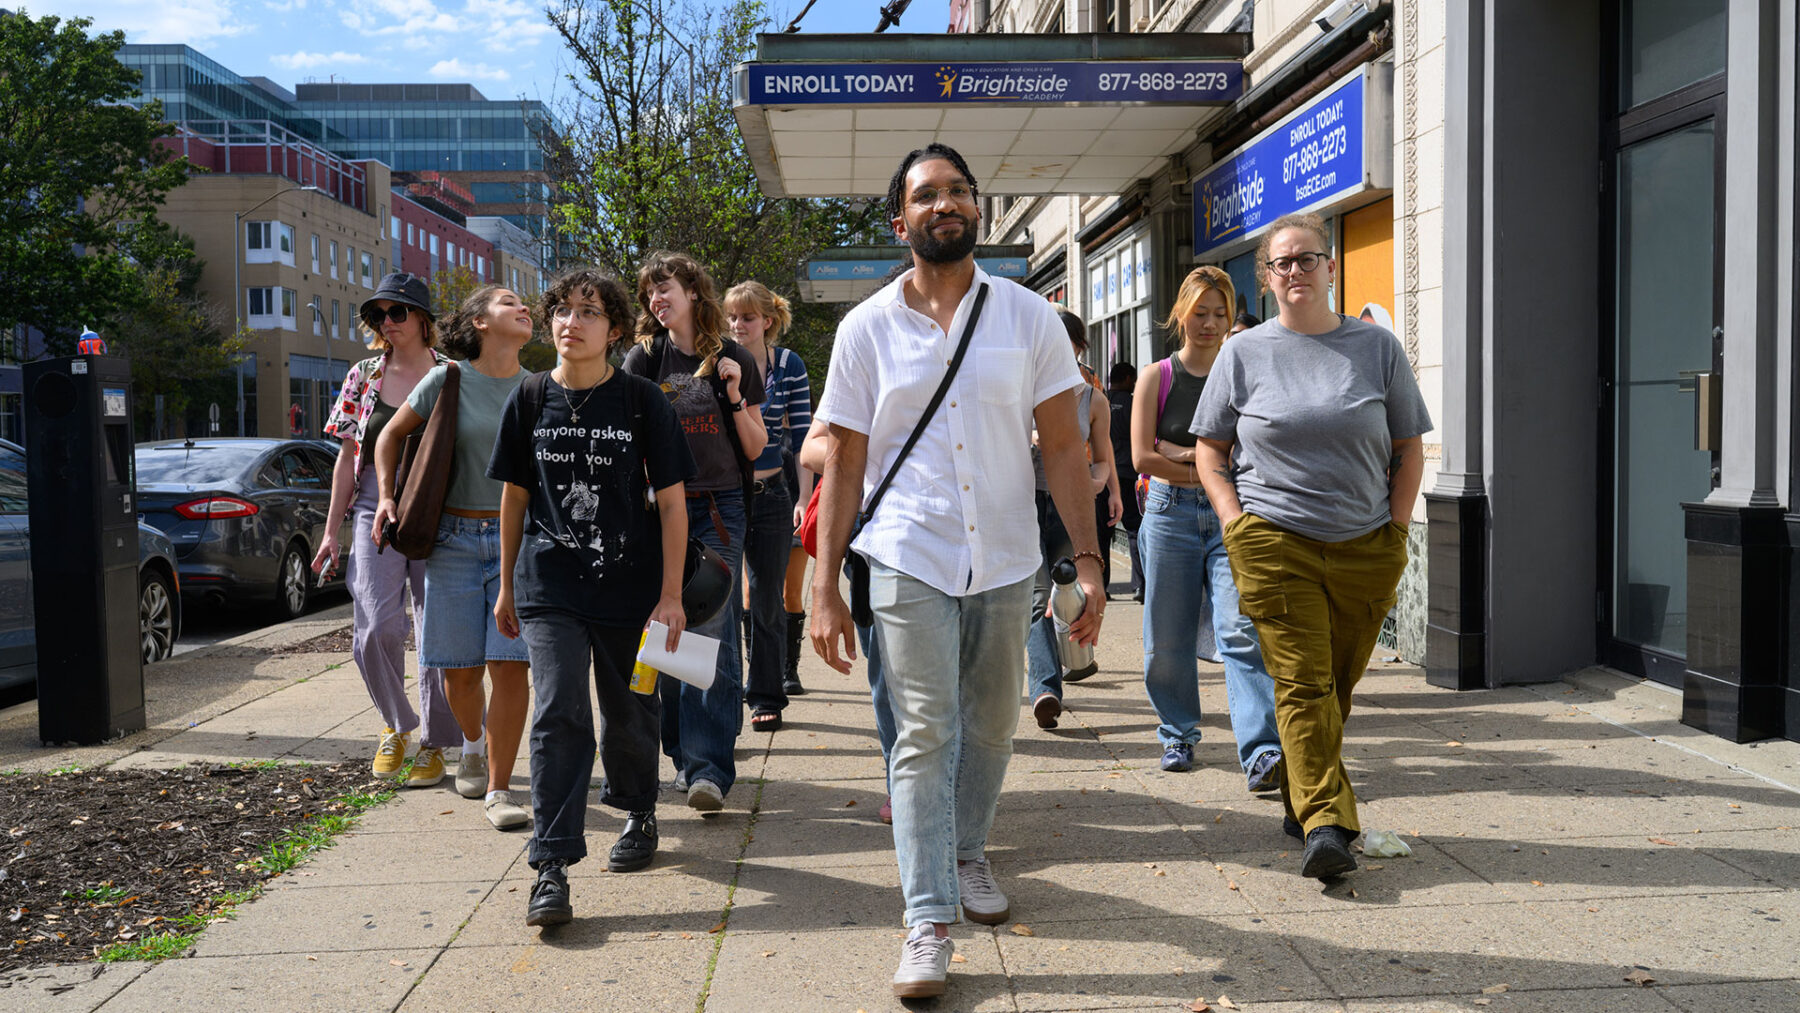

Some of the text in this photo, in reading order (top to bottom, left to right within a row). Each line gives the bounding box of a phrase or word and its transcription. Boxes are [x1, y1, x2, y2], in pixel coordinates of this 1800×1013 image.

[764, 74, 914, 94] ENROLL TODAY!
[958, 74, 1068, 96] Brightside
[1098, 72, 1228, 91] 877-868-2273
[1290, 99, 1343, 148] ENROLL TODAY!
[1282, 124, 1347, 184] 877-868-2273
[1295, 171, 1337, 202] bsaECE.com
[1212, 169, 1264, 228] Brightside
[533, 425, 633, 442] veryone asked
[536, 447, 613, 466] about you
